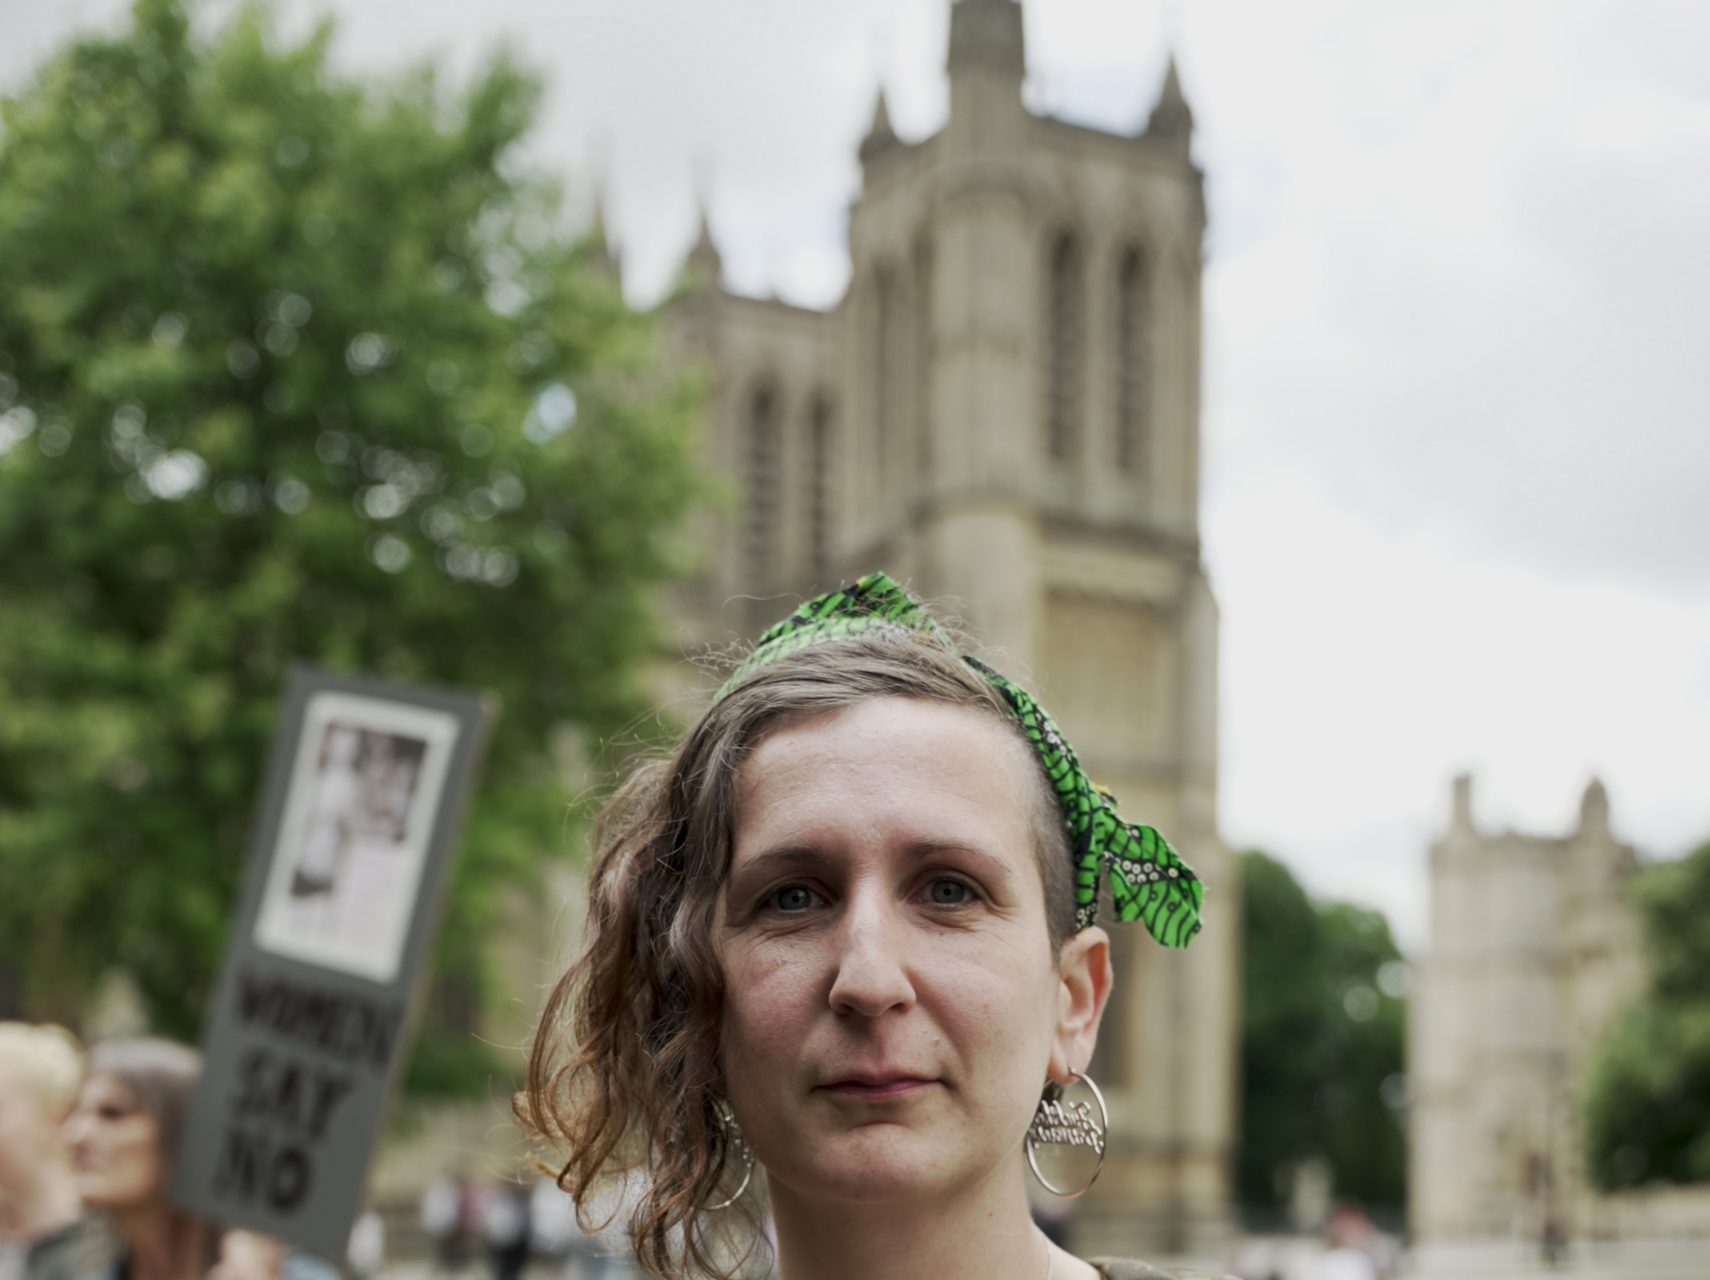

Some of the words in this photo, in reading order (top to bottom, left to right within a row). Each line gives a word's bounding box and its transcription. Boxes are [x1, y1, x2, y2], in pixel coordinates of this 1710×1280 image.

[236, 974, 403, 1073] WOMEN
[232, 1046, 353, 1139] SAY
[213, 1126, 313, 1216] NO
